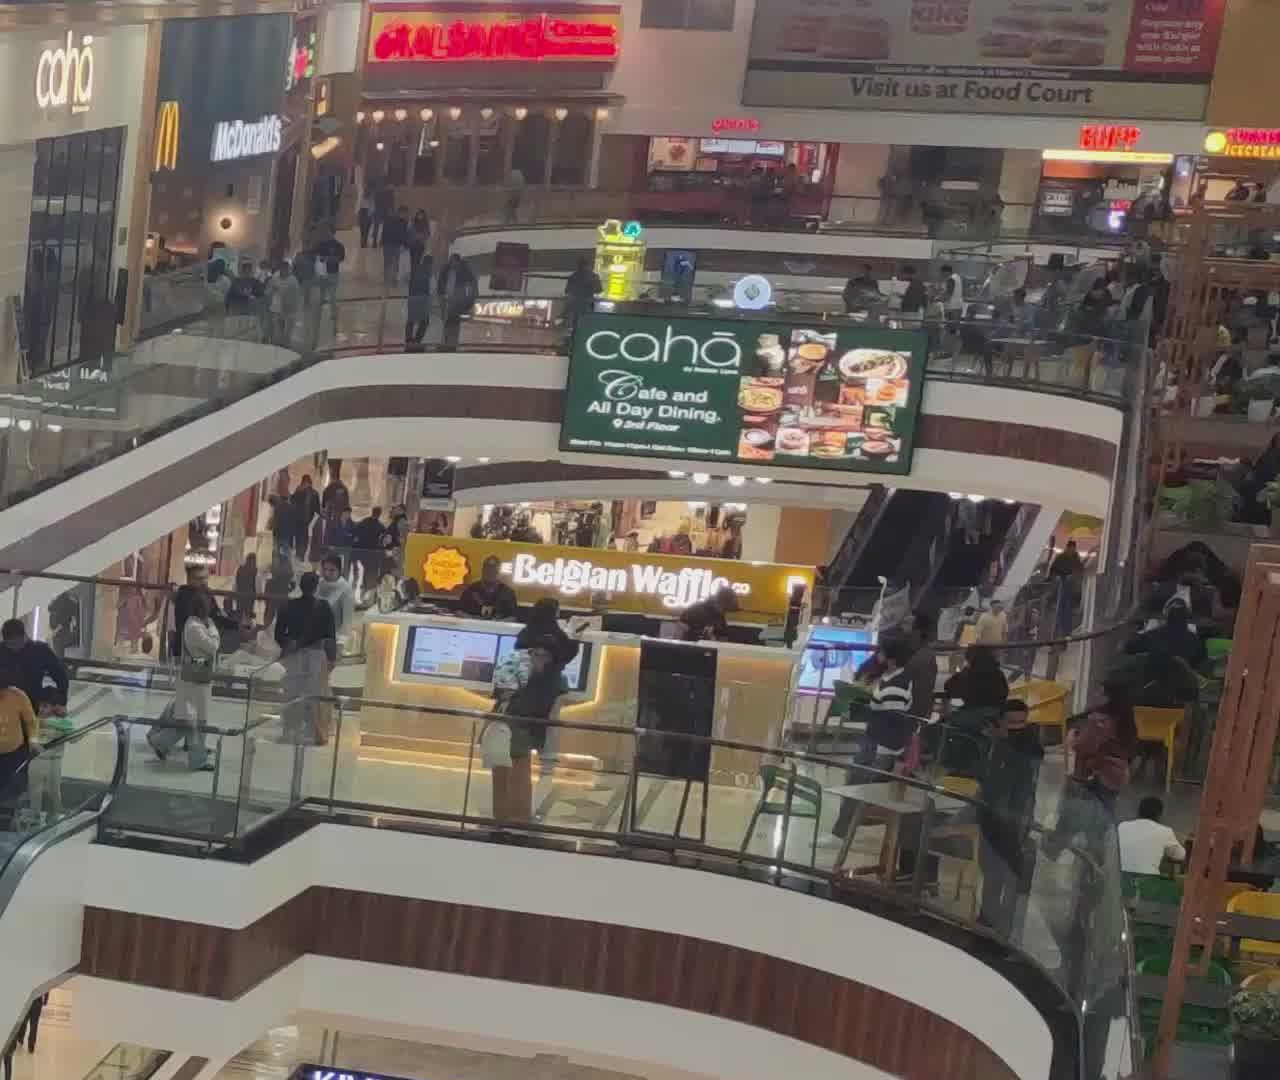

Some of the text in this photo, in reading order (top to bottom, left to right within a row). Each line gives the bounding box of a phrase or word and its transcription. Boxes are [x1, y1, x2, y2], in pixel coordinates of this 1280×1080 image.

[850, 77, 1093, 104] Visit us at Food Court
[209, 114, 282, 162] McDonald's
[597, 369, 708, 403] Cafe and
[587, 401, 721, 424] All Day Dining.
[514, 554, 627, 594] Belgian
